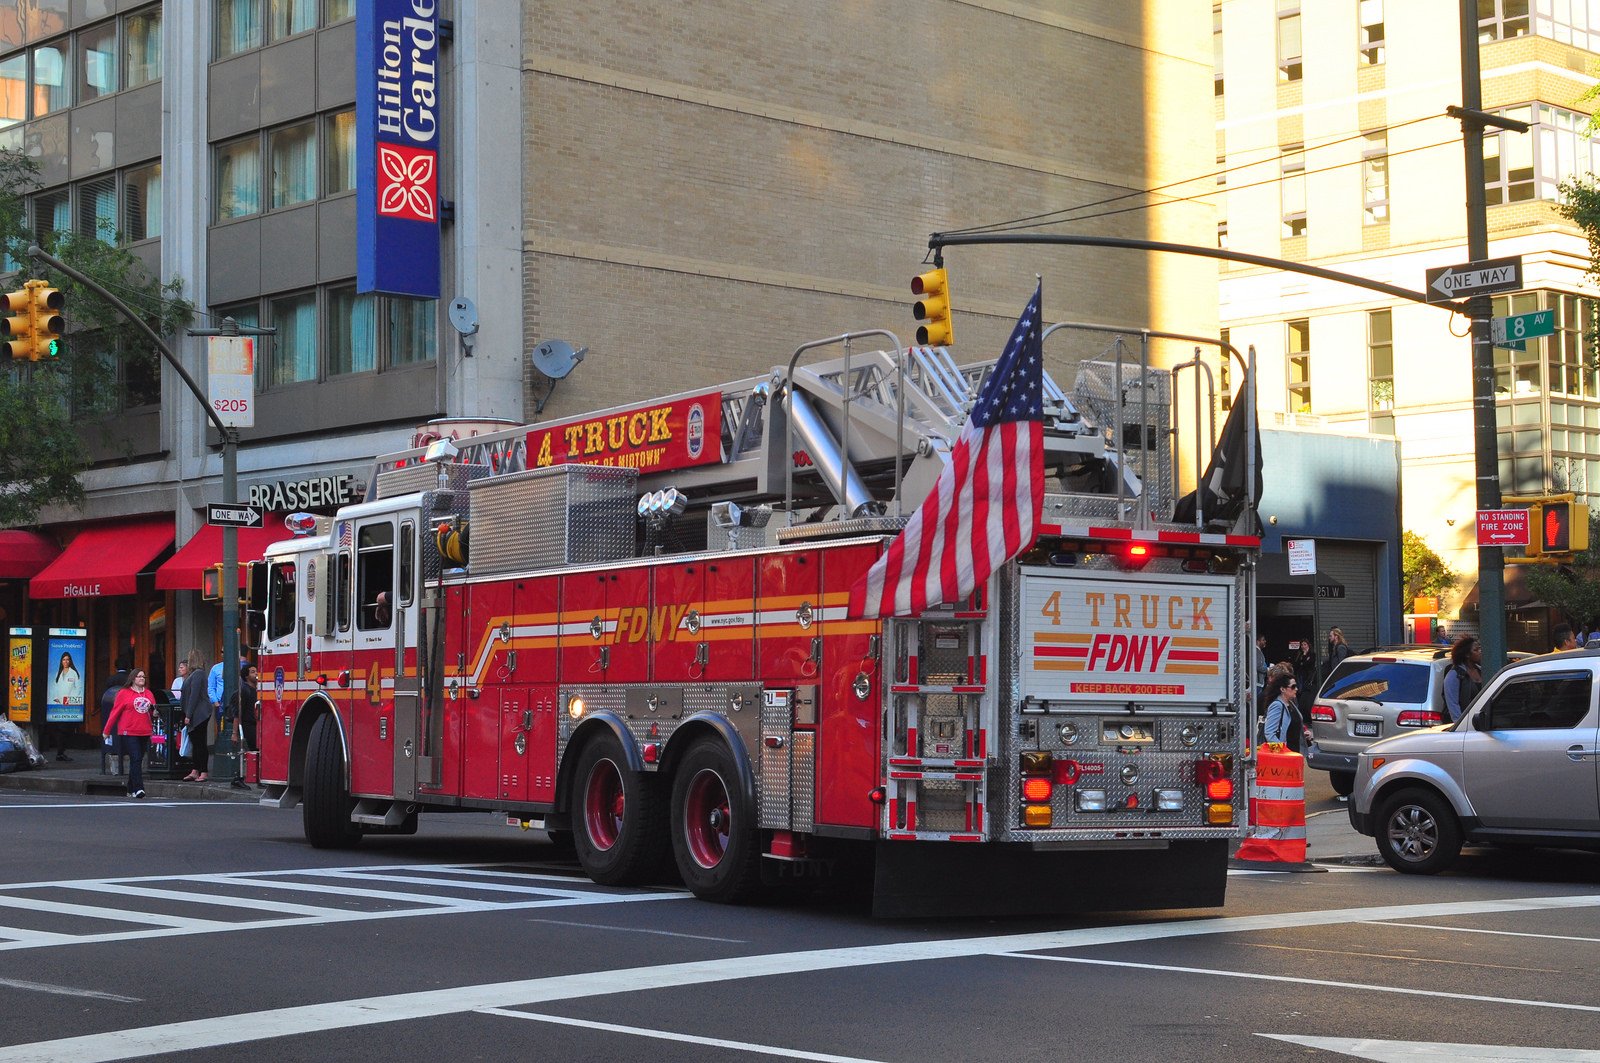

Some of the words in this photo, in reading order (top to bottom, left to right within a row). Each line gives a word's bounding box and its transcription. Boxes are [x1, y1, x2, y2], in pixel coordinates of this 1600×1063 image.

[378, 20, 401, 136] Hilton
[403, 0, 435, 142] Garde
[1443, 274, 1472, 290] ONE
[1480, 268, 1508, 285] WAY
[1513, 317, 1526, 337] 8
[1534, 313, 1546, 325] AV
[214, 399, 248, 412] $205
[537, 431, 553, 466] 4
[565, 406, 673, 457] TRUCK
[249, 475, 350, 512] BRASSERIE
[215, 510, 232, 520] ONE
[237, 511, 254, 521] WAY
[1480, 513, 1489, 521] NO
[1492, 512, 1525, 521] STANDING
[1481, 523, 1499, 531] FIRE
[1503, 522, 1524, 531] ZONE
[1332, 586, 1340, 597] W
[614, 604, 687, 644] FDNY
[1041, 590, 1062, 626] 4
[1086, 592, 1214, 631] TRUCK
[1087, 633, 1171, 673] FDNY
[367, 661, 380, 704] 4
[1075, 683, 1103, 694] KEEP
[1105, 684, 1133, 695] BACK
[1135, 685, 1153, 695] 200
[1156, 685, 1180, 695] FEET
